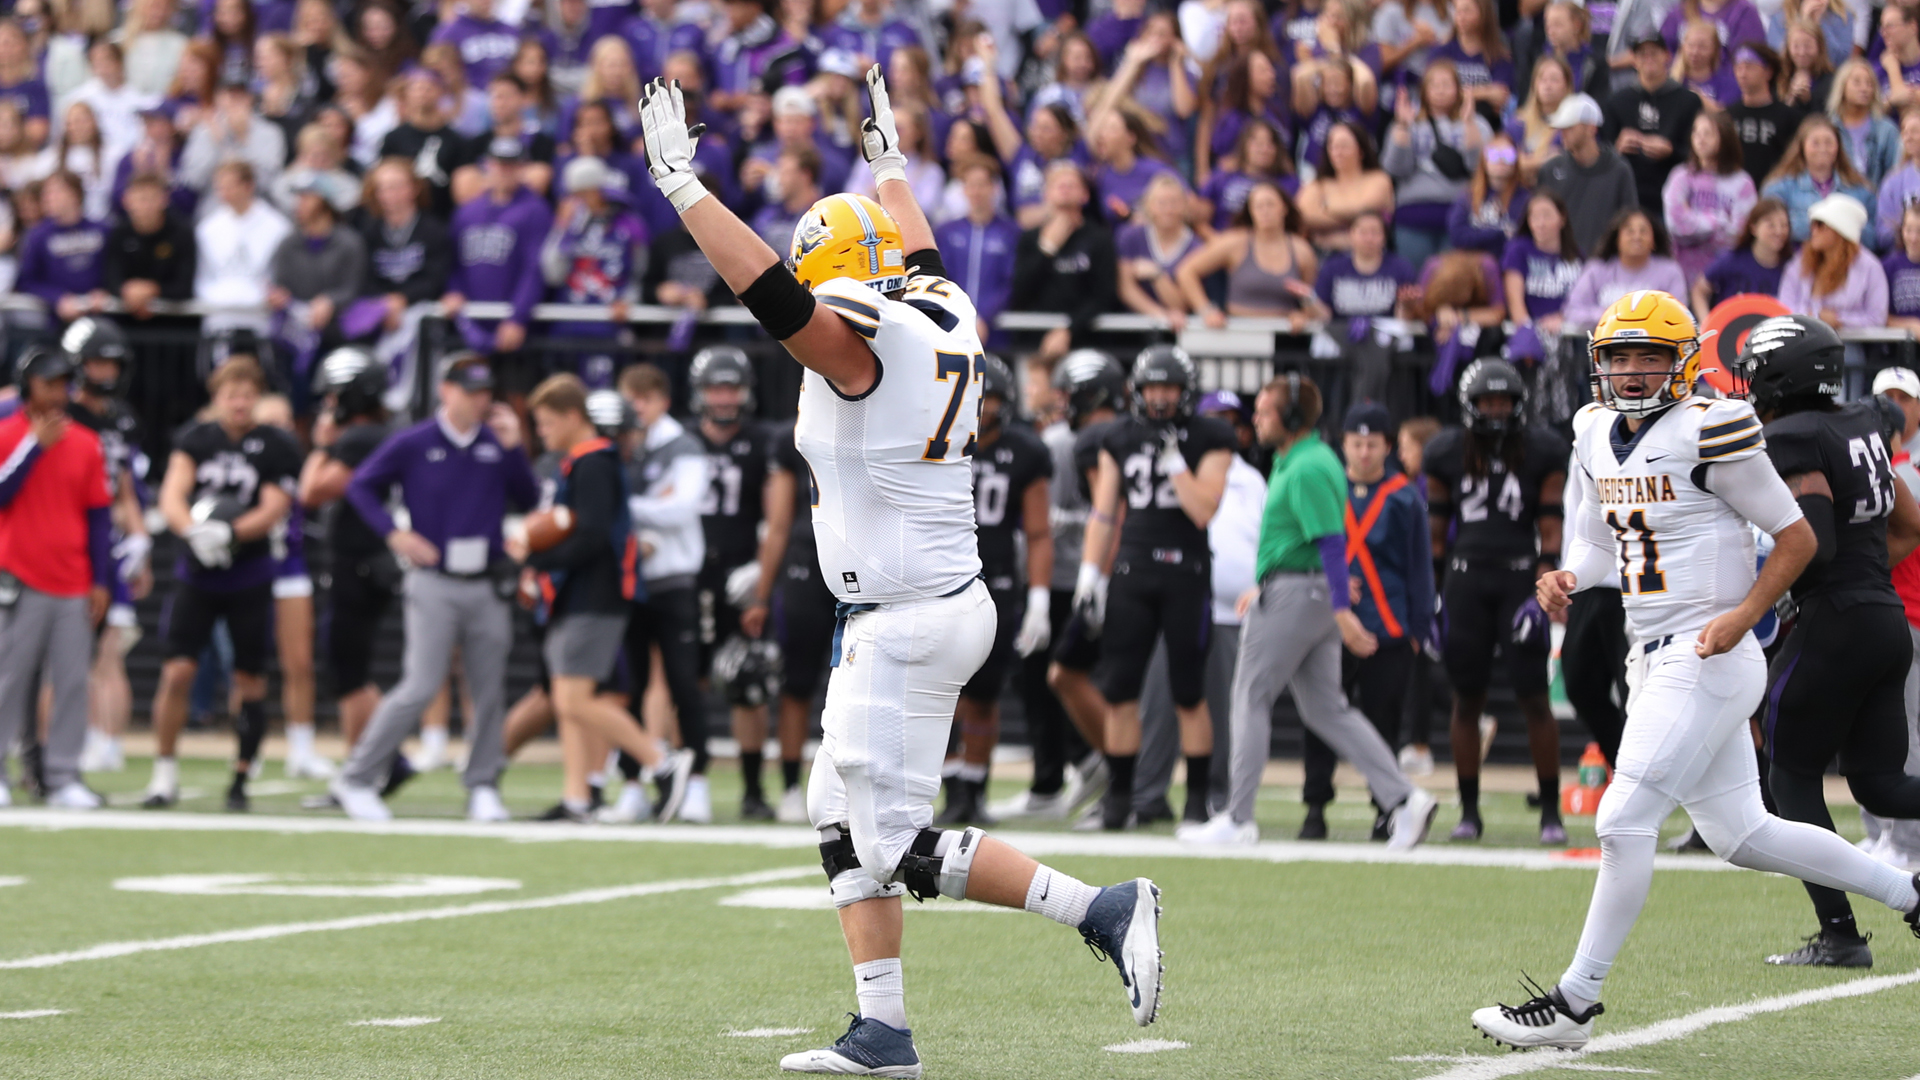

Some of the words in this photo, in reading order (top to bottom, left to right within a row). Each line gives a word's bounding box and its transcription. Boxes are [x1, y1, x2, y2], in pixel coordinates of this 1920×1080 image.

[1460, 472, 1524, 523] 24
[1849, 432, 1897, 524] 33
[1606, 508, 1668, 595] 11
